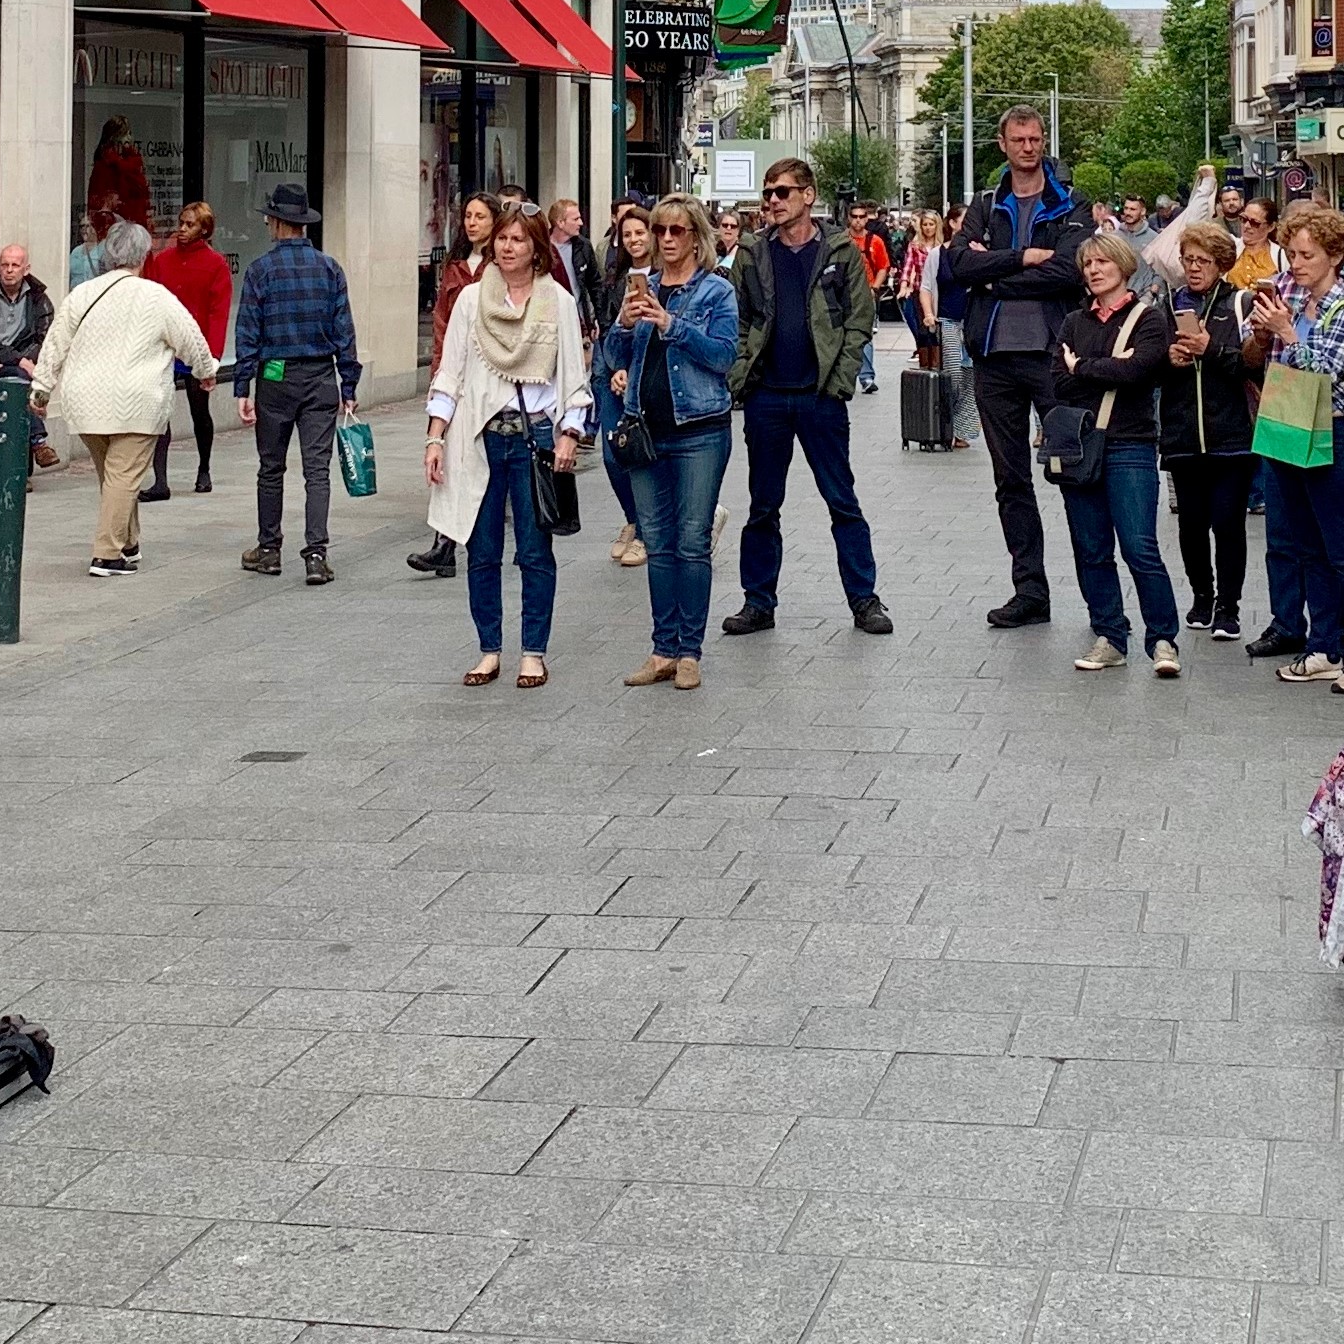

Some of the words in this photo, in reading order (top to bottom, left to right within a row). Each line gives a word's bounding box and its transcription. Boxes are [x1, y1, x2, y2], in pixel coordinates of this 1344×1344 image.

[625, 9, 710, 28] ELEBRATING
[656, 31, 709, 51] YEARS
[76, 42, 178, 90] OTLIGHT
